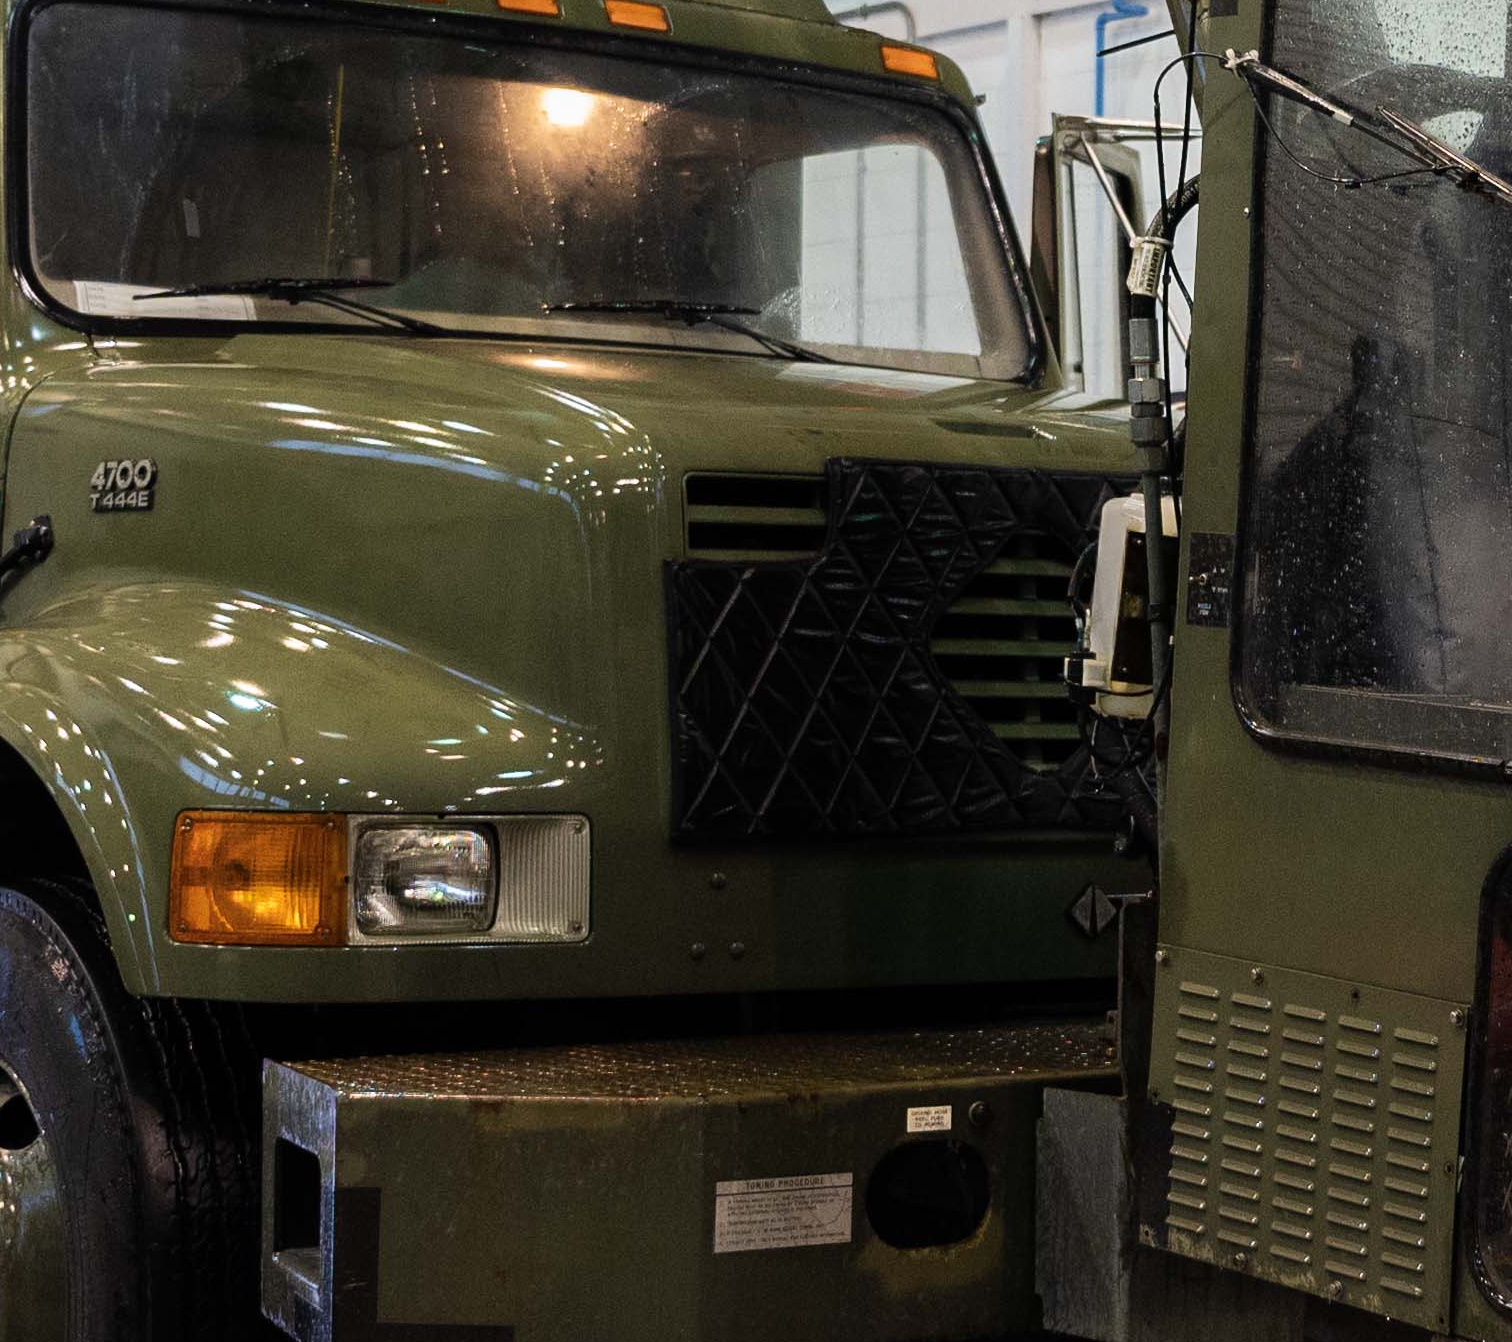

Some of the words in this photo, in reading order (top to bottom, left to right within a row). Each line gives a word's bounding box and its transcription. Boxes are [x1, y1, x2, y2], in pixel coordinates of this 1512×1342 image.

[89, 458, 153, 491] 4700
[89, 493, 100, 510] T
[103, 491, 150, 509] 444E
